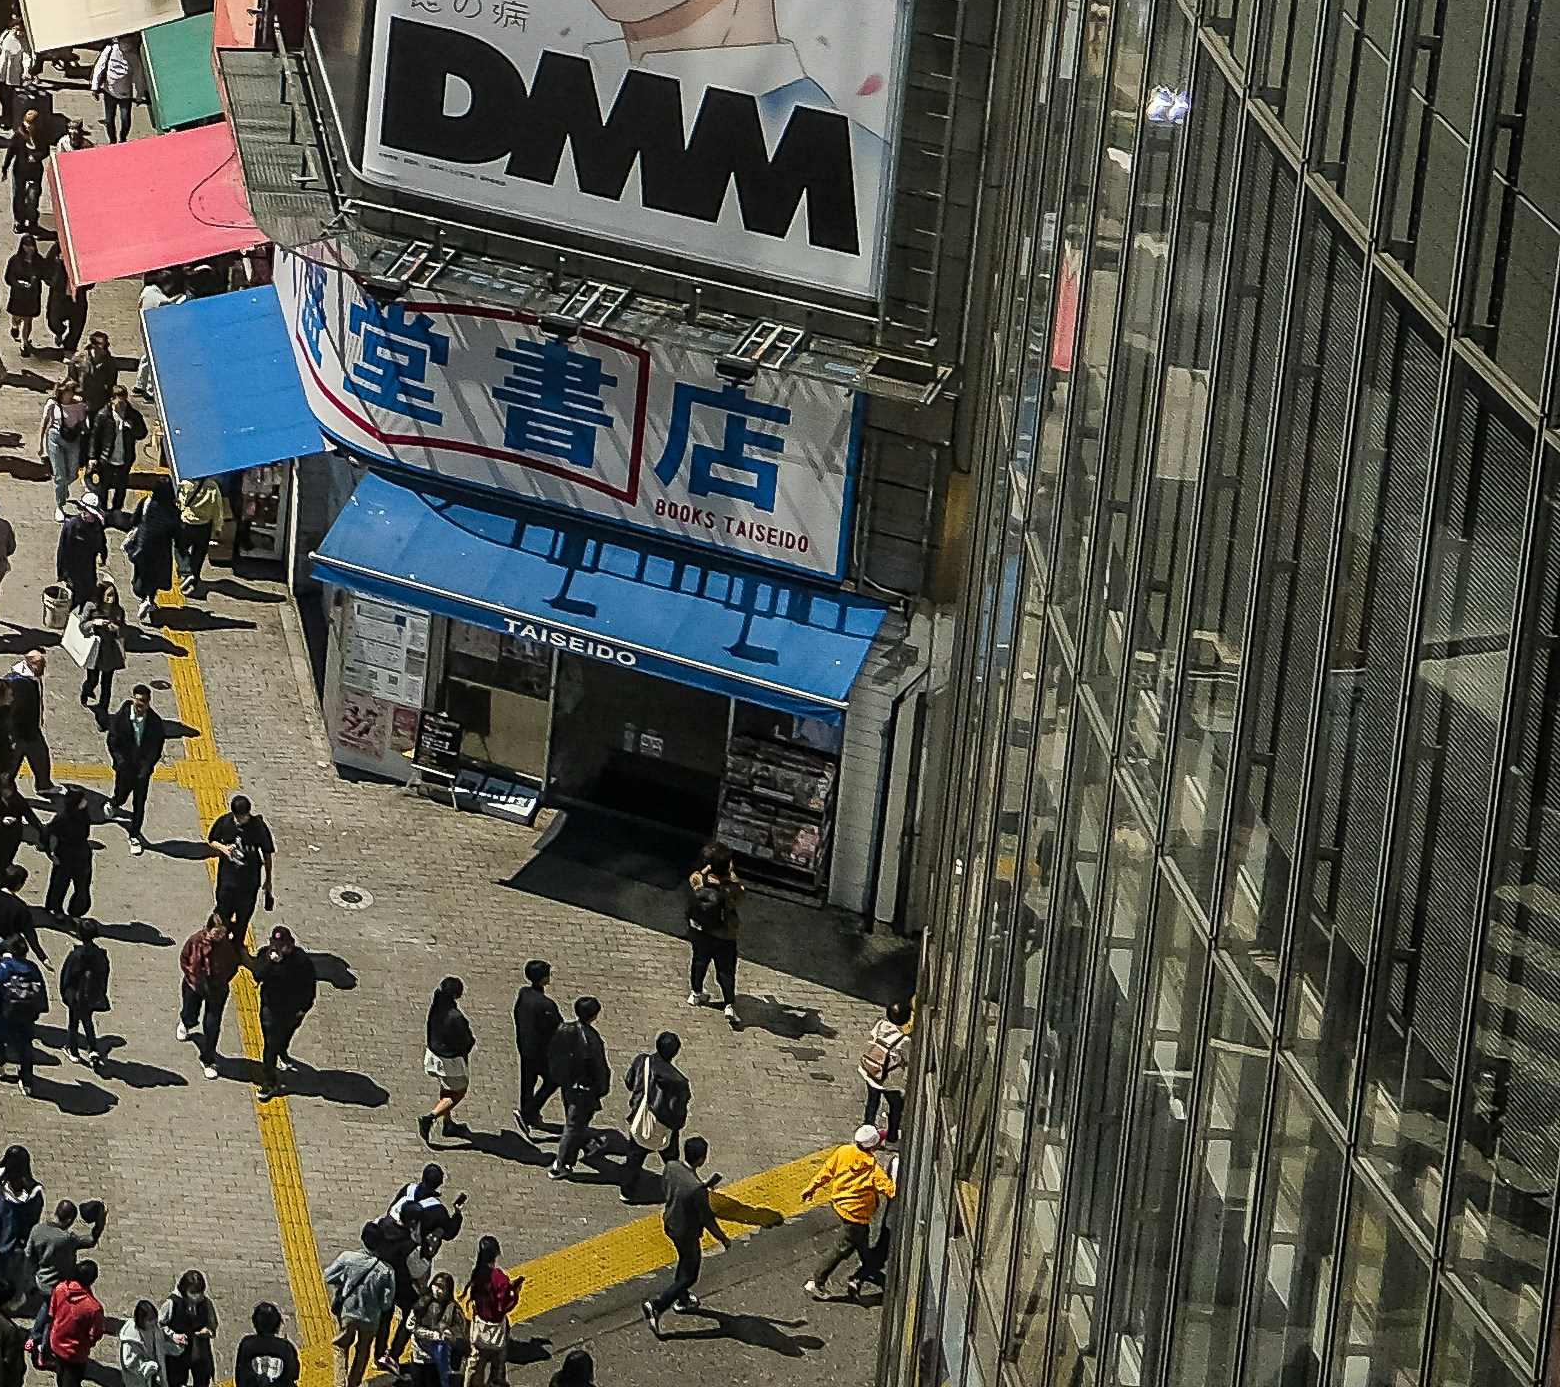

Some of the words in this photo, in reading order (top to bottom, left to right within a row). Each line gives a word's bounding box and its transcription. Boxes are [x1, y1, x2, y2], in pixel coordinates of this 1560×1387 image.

[380, 16, 862, 256] DMM
[654, 497, 716, 530] BOOKS
[723, 515, 810, 555] TAISEIDO
[502, 616, 638, 668] TAISEIDO
